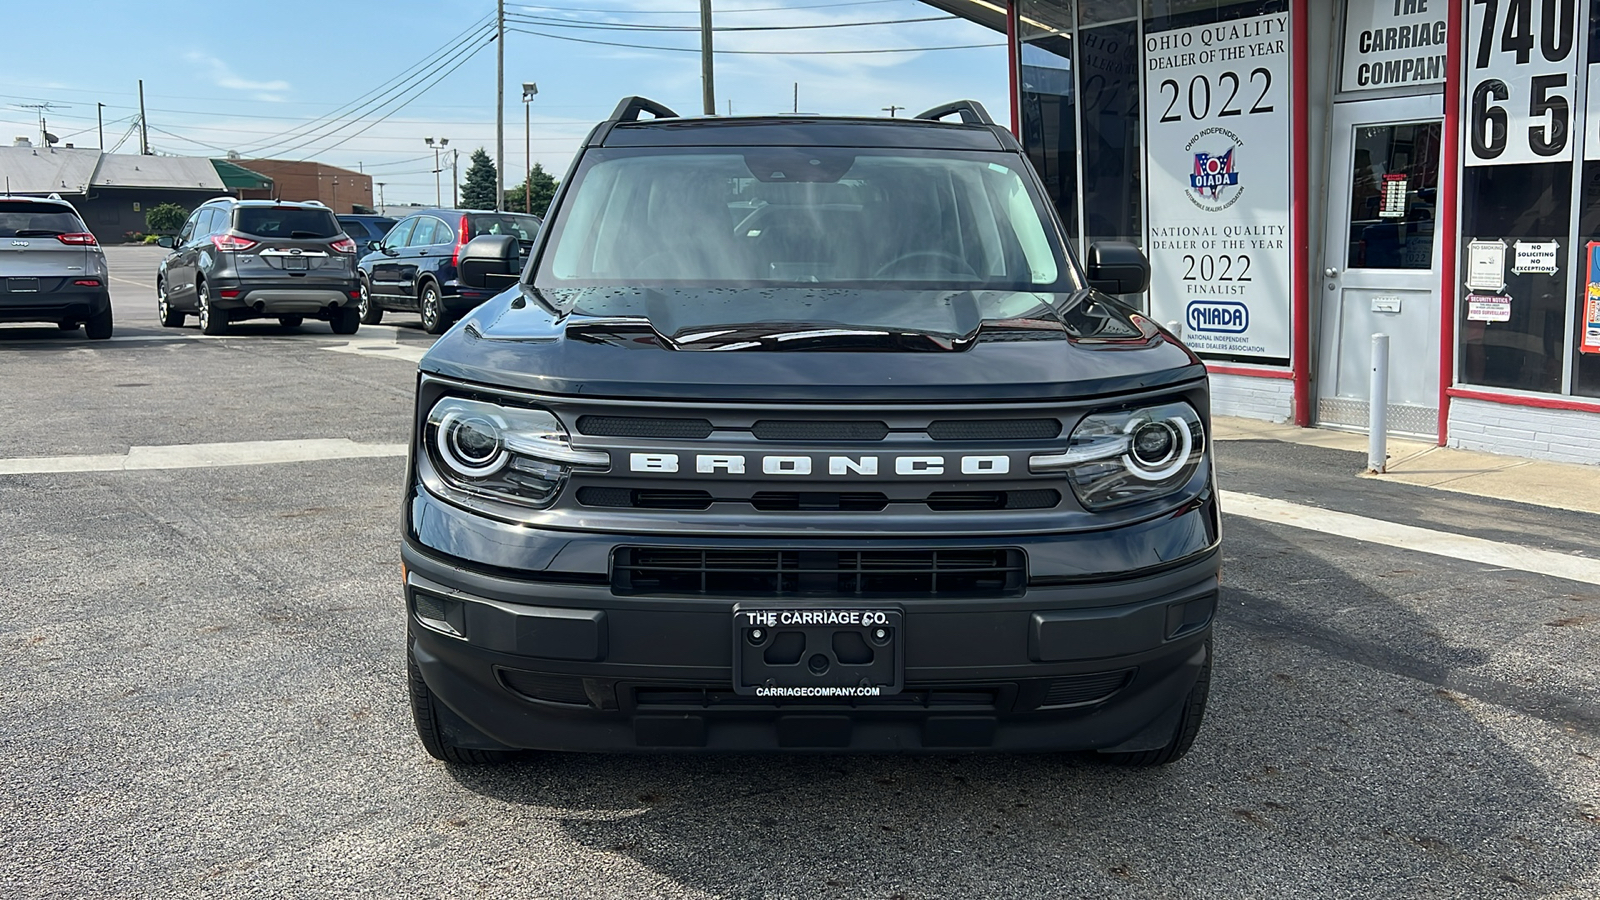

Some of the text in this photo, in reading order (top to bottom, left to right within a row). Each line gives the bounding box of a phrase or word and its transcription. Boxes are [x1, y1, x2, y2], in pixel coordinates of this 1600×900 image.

[1393, 0, 1428, 16] THE
[1147, 17, 1287, 52] OHIO QUALITY
[1358, 21, 1446, 53] CARRIAG
[1474, 0, 1574, 68] 740
[1149, 52, 1196, 71] DEALER
[1200, 50, 1216, 64] OF
[1219, 45, 1246, 61] THE
[1249, 40, 1285, 57] YEAR
[1160, 67, 1274, 123] 2022
[1185, 127, 1244, 151] OHIO INDEPENDENT
[1195, 174, 1230, 186] OIADA
[1223, 185, 1245, 209] ASSOCIATION
[1151, 225, 1285, 238] NATIONAL QUALITY
[1153, 239, 1283, 249] DEALER OF THE YEAR
[1182, 254, 1252, 281] 2022
[1187, 284, 1246, 295] FINALIST
[1191, 307, 1243, 330] NIADA
[1213, 335, 1249, 343] INDEPENDENT
[1229, 344, 1265, 352] ASSOCIATION
[630, 453, 1010, 476] BRONCO
[747, 612, 889, 625] THE CARRIAGE CO.
[756, 687, 880, 696] CARRIAGECOMPANY.COM
